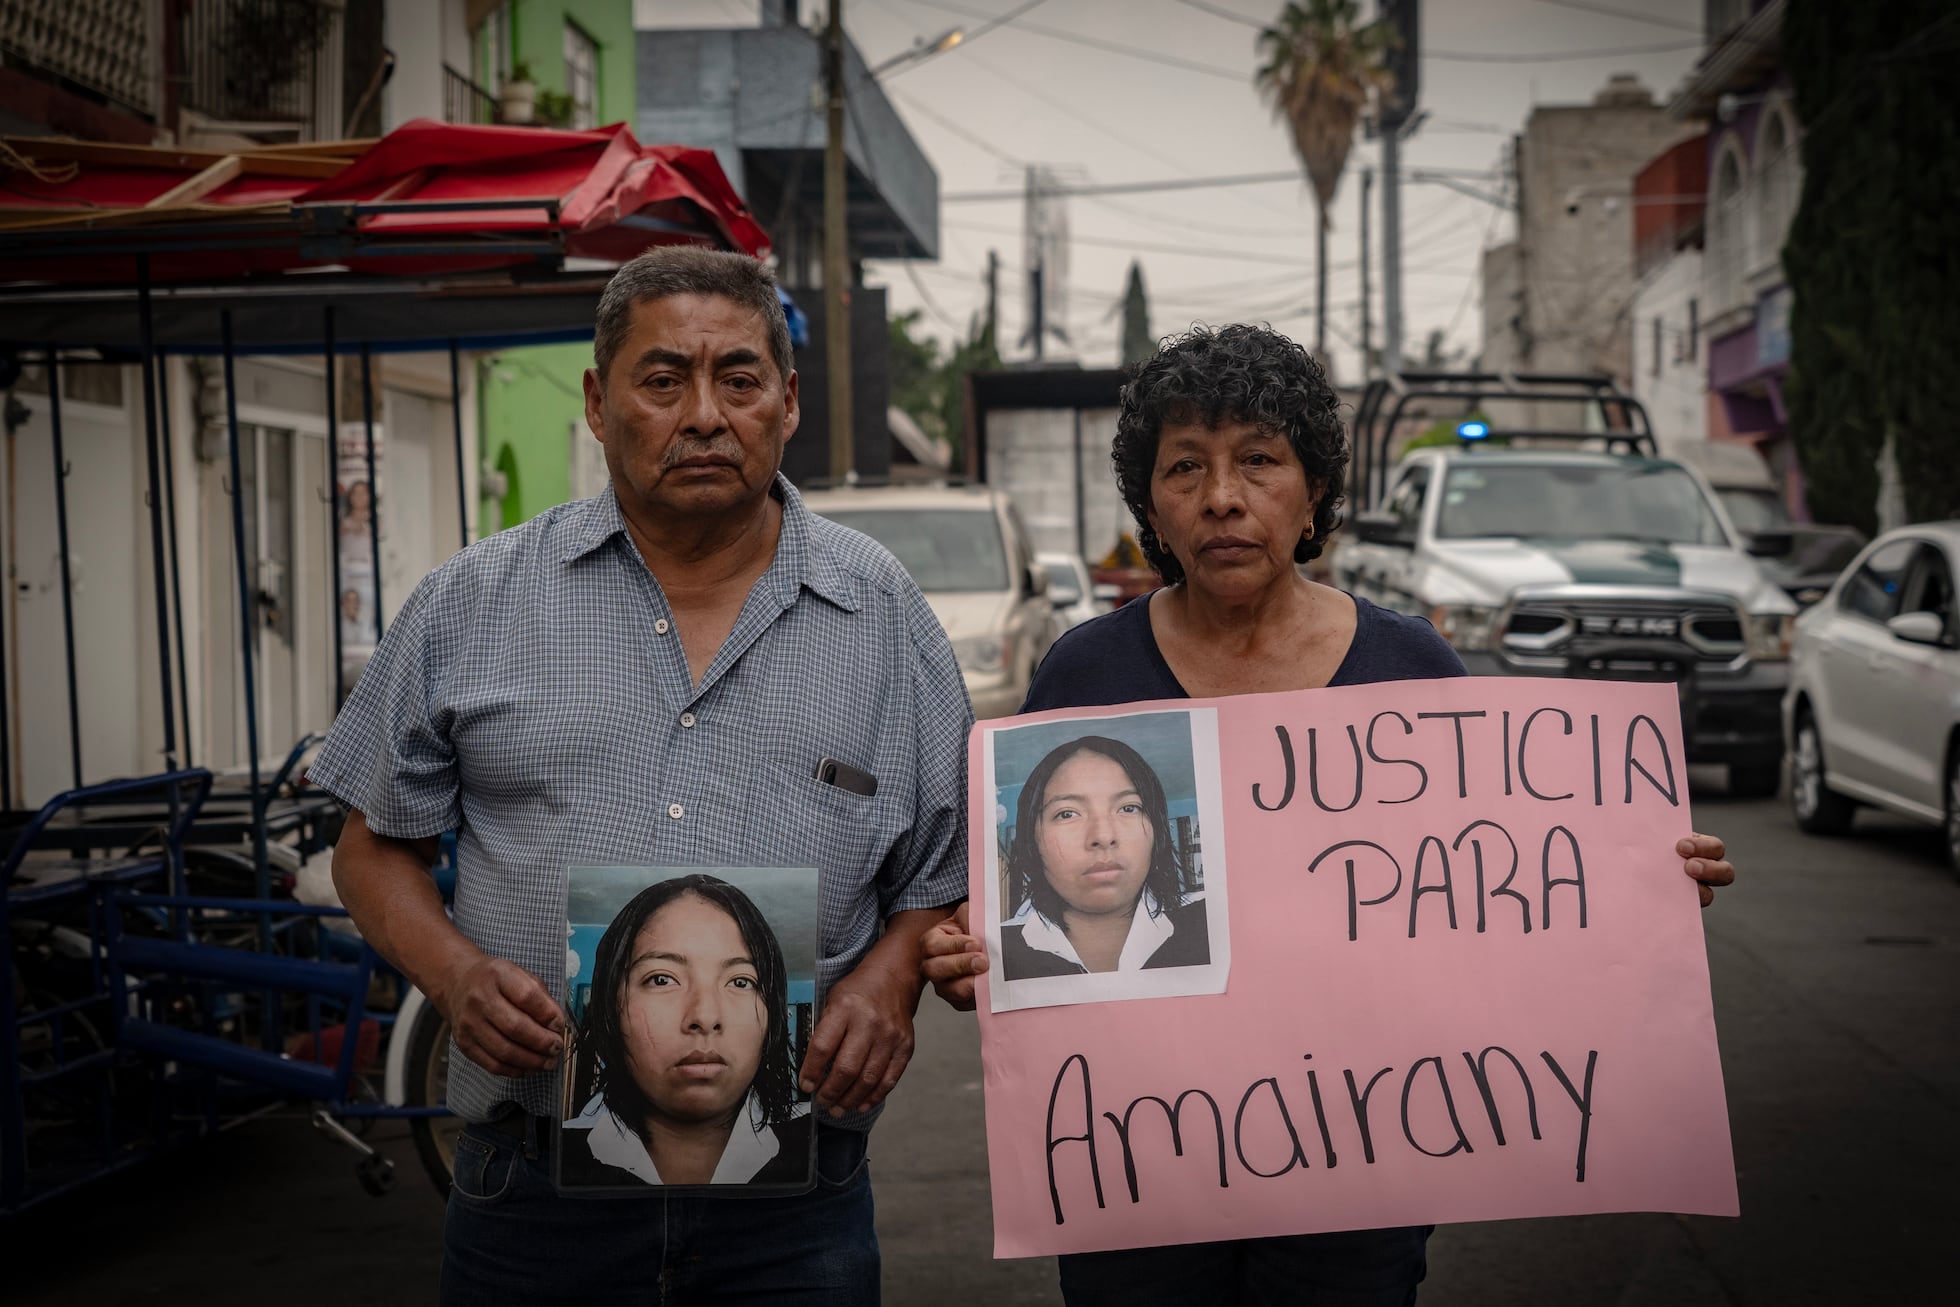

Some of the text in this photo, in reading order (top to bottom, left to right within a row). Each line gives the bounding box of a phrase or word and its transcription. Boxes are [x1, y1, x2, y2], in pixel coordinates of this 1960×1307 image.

[1251, 707, 1680, 813] JUSTICIA
[1307, 819, 1588, 942] PARA
[1045, 1045, 1599, 1226] Amairany
